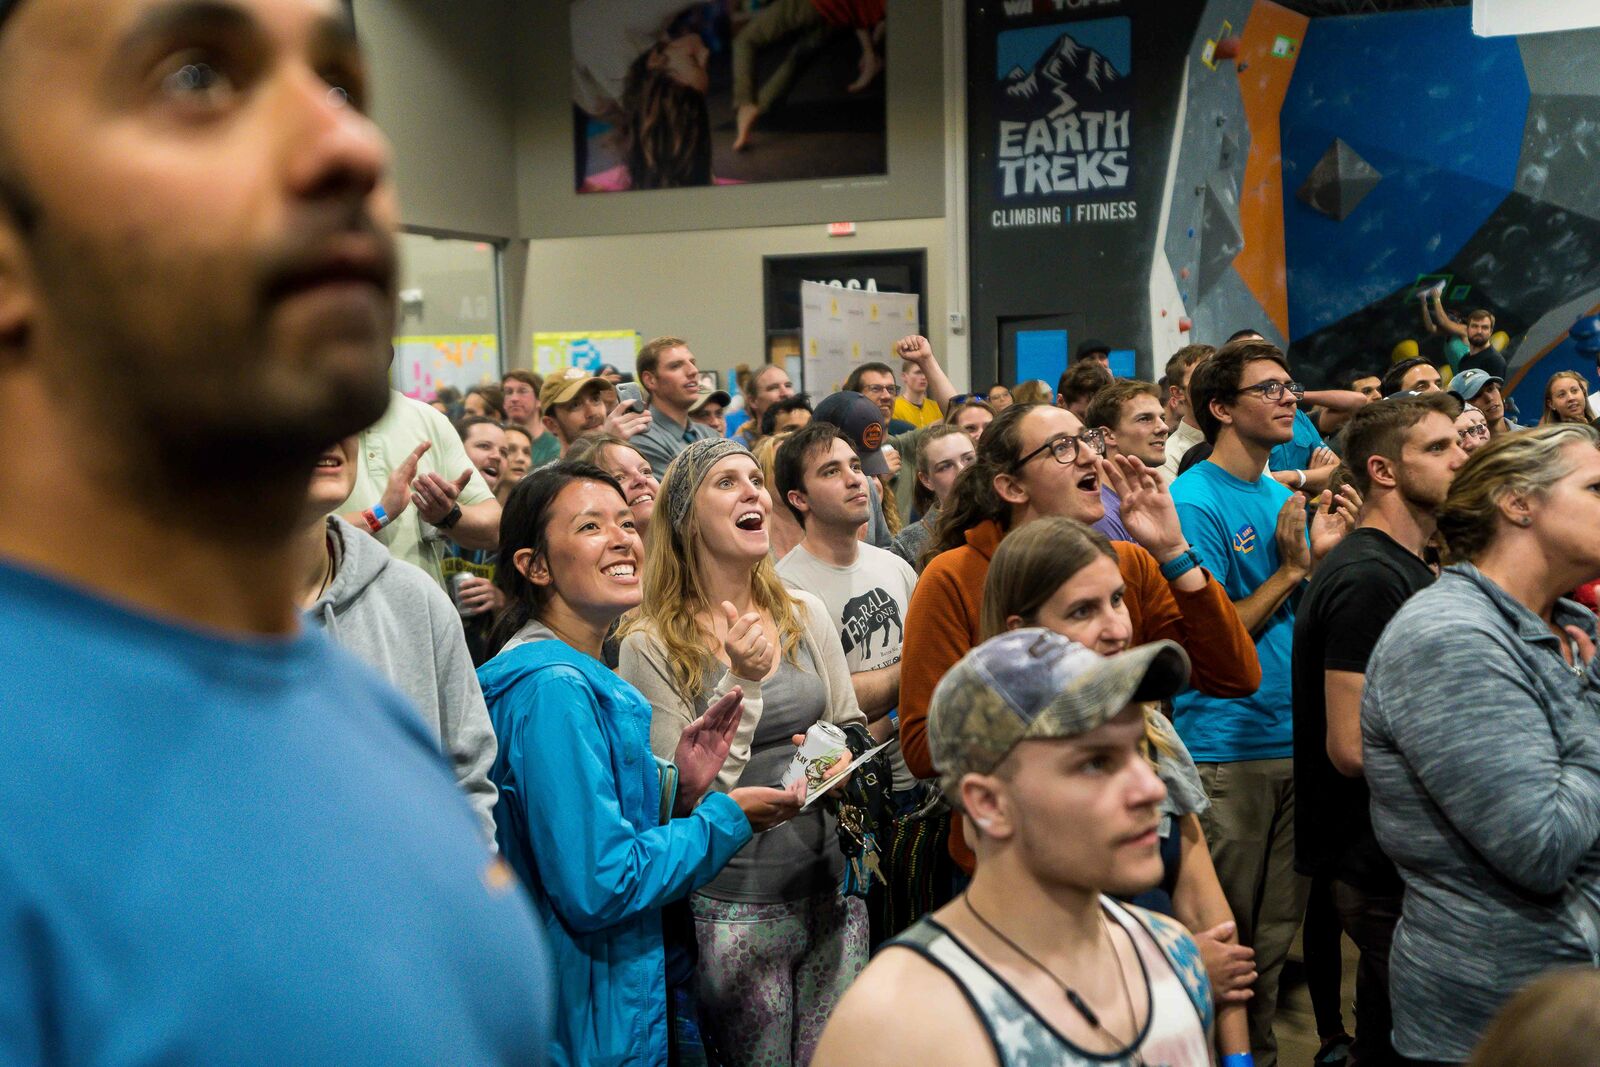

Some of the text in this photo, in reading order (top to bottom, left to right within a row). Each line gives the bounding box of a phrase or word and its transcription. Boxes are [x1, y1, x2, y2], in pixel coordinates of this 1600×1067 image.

[999, 110, 1130, 157] EARTH
[999, 151, 1130, 196] TREKS
[992, 201, 1137, 227] CLIMBING FITNESS
[843, 588, 891, 648] FERAL
[875, 606, 896, 624] ONE
